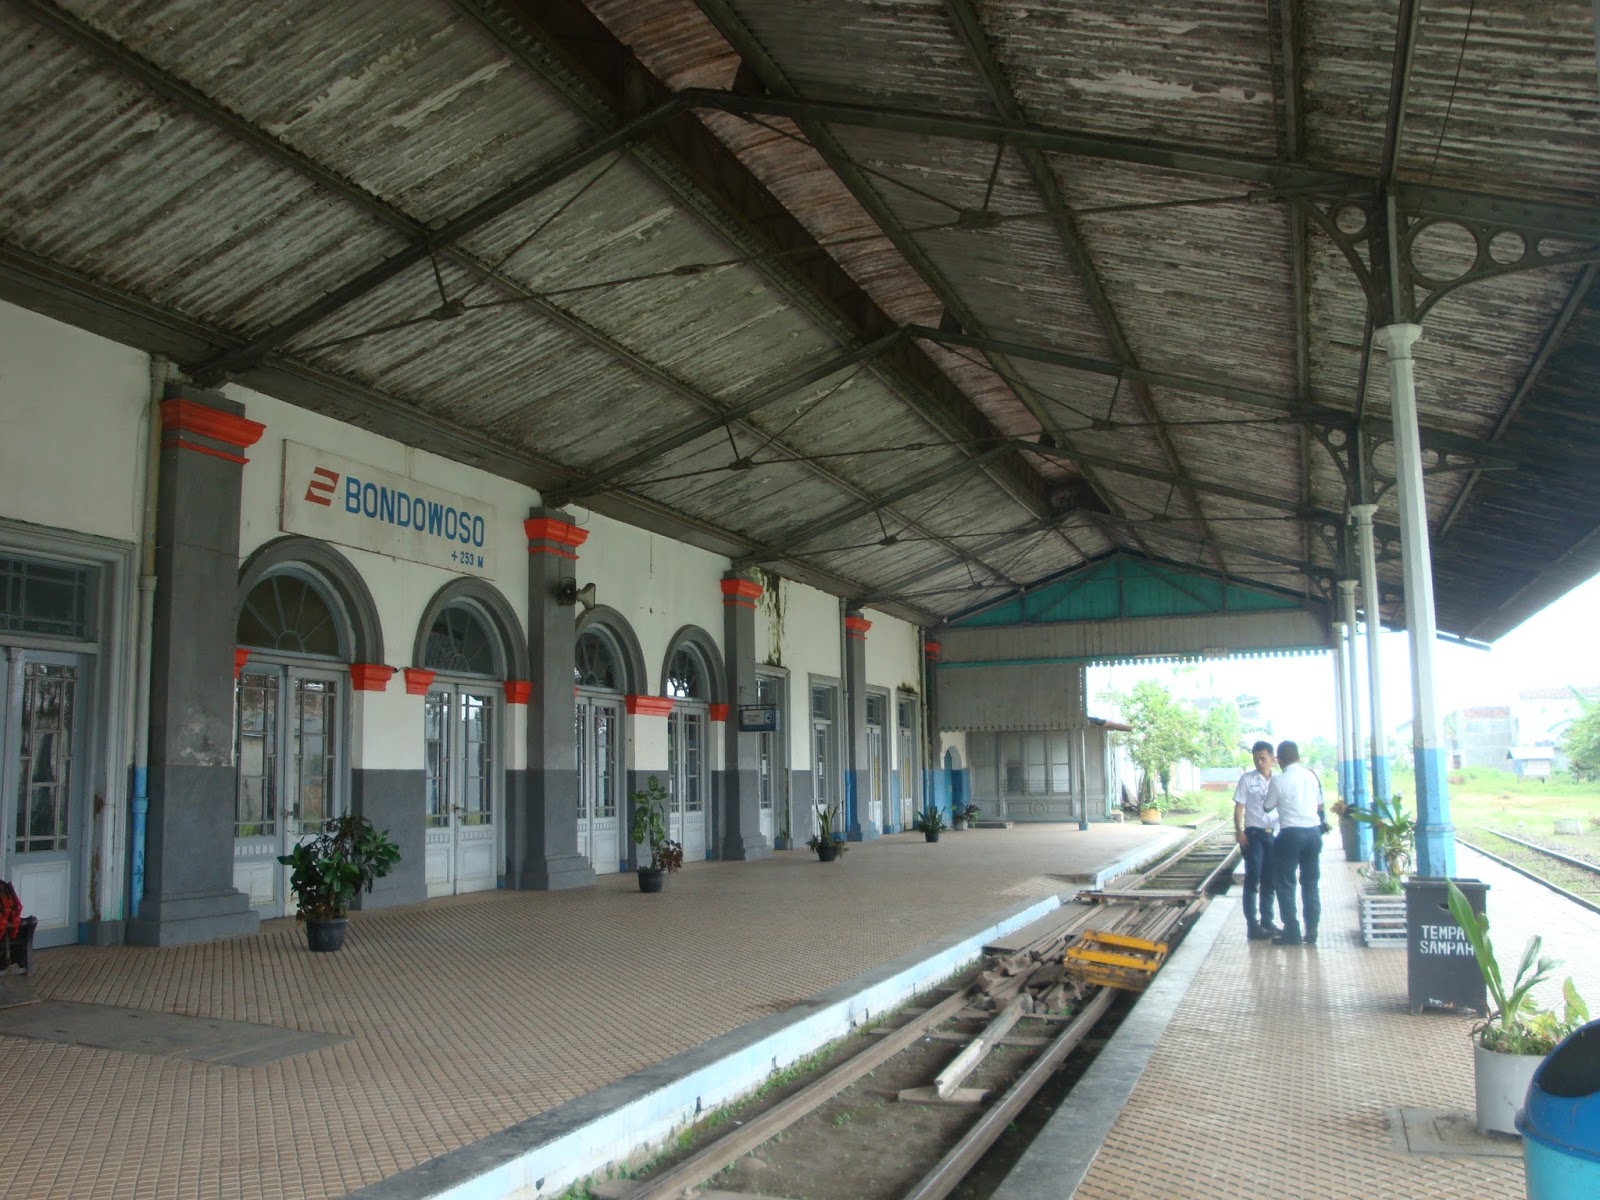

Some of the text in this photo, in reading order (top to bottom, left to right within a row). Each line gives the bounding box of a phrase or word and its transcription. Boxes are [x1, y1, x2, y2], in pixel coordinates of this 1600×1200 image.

[346, 476, 485, 547] BONDOWOSO
[460, 551, 474, 566] 253
[477, 555, 484, 569] M
[1421, 925, 1466, 940] TEMPA
[1420, 940, 1475, 956] SAMPAH
